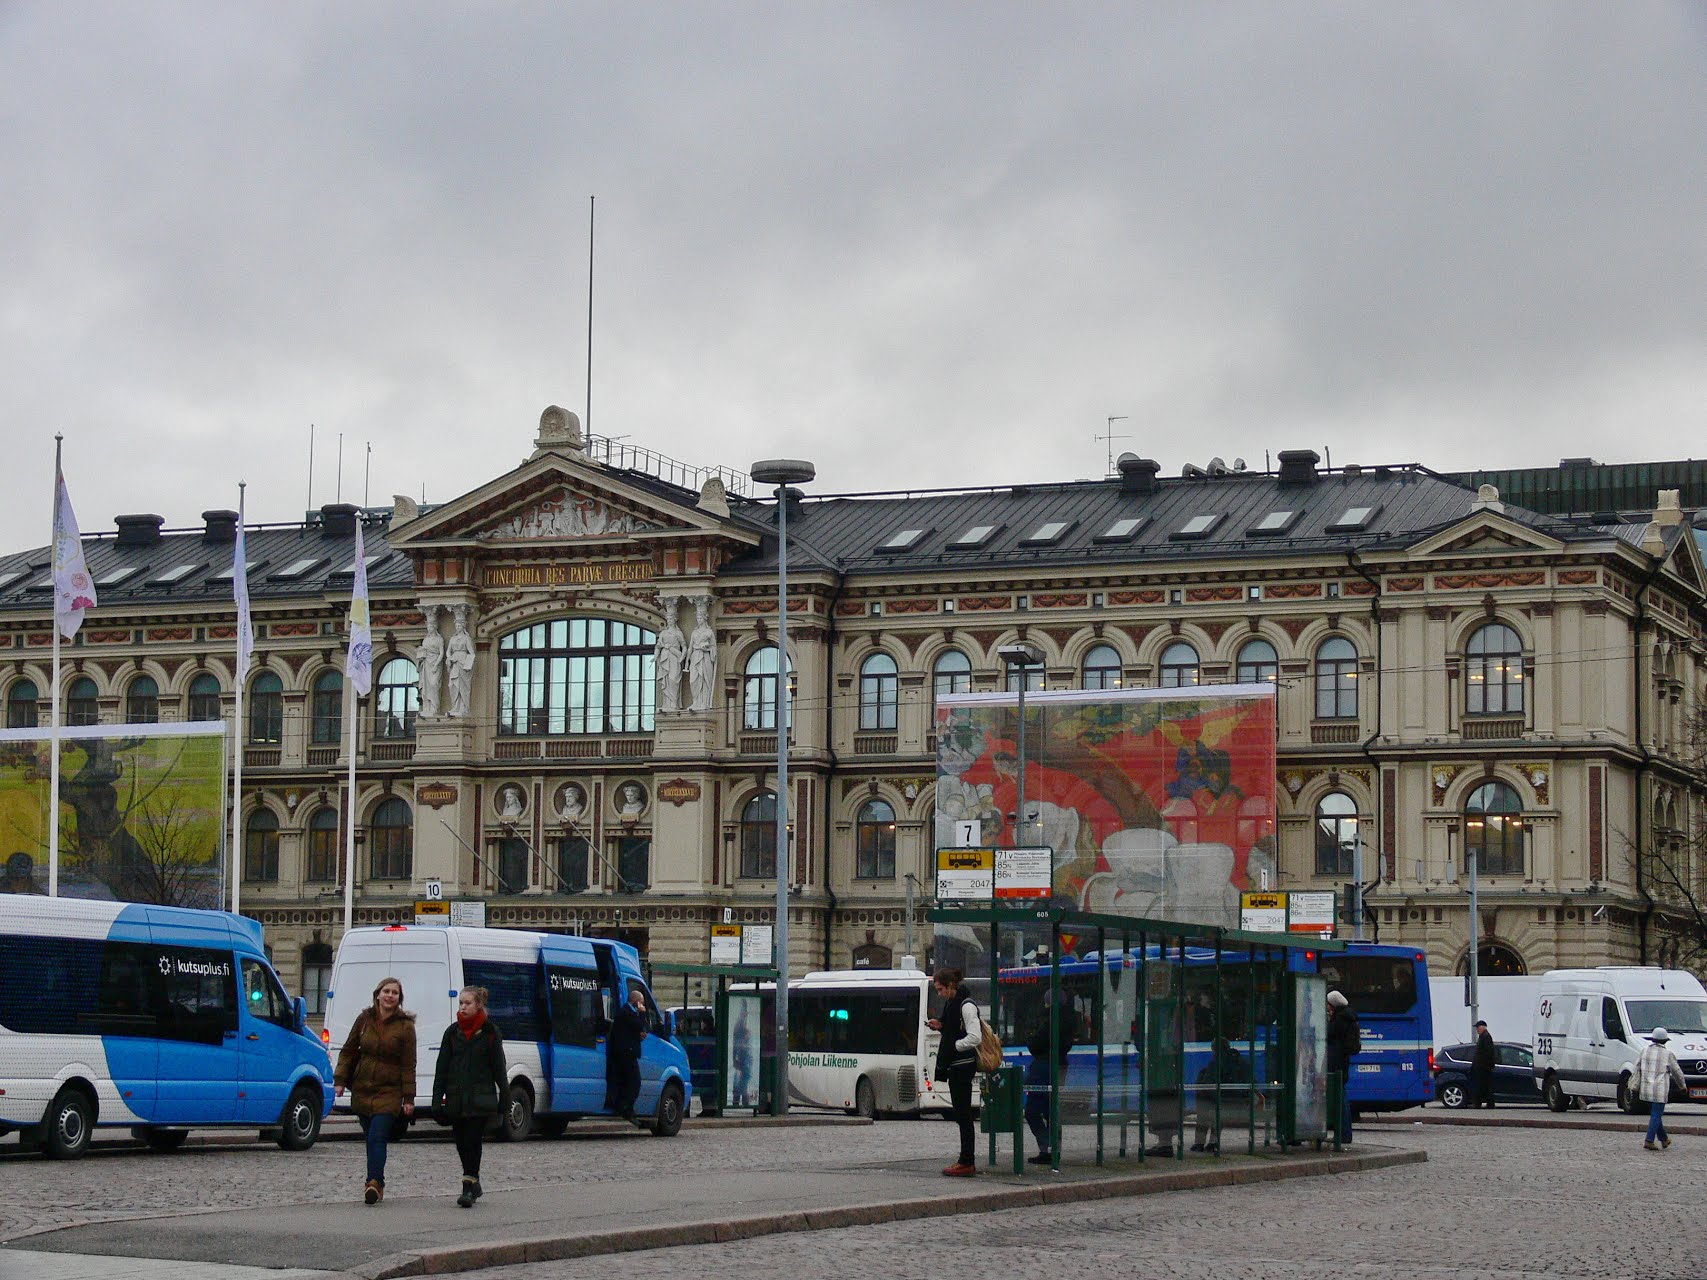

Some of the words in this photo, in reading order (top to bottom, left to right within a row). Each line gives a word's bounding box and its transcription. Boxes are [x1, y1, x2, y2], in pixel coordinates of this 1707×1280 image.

[486, 567, 541, 585] CONCORDIA
[545, 566, 565, 584] RES
[570, 565, 603, 583] PARVÆ
[964, 825, 972, 842] 7
[428, 884, 440, 897] 10
[970, 880, 990, 888] 2047
[940, 890, 949, 898] 71
[725, 910, 731, 921] 10
[177, 959, 230, 976] kutsuplus.fi
[562, 977, 597, 991] kutsuplus.fi
[1537, 1037, 1553, 1056] 213
[787, 1053, 820, 1067] Pohjolan
[822, 1054, 858, 1068] Liikenne
